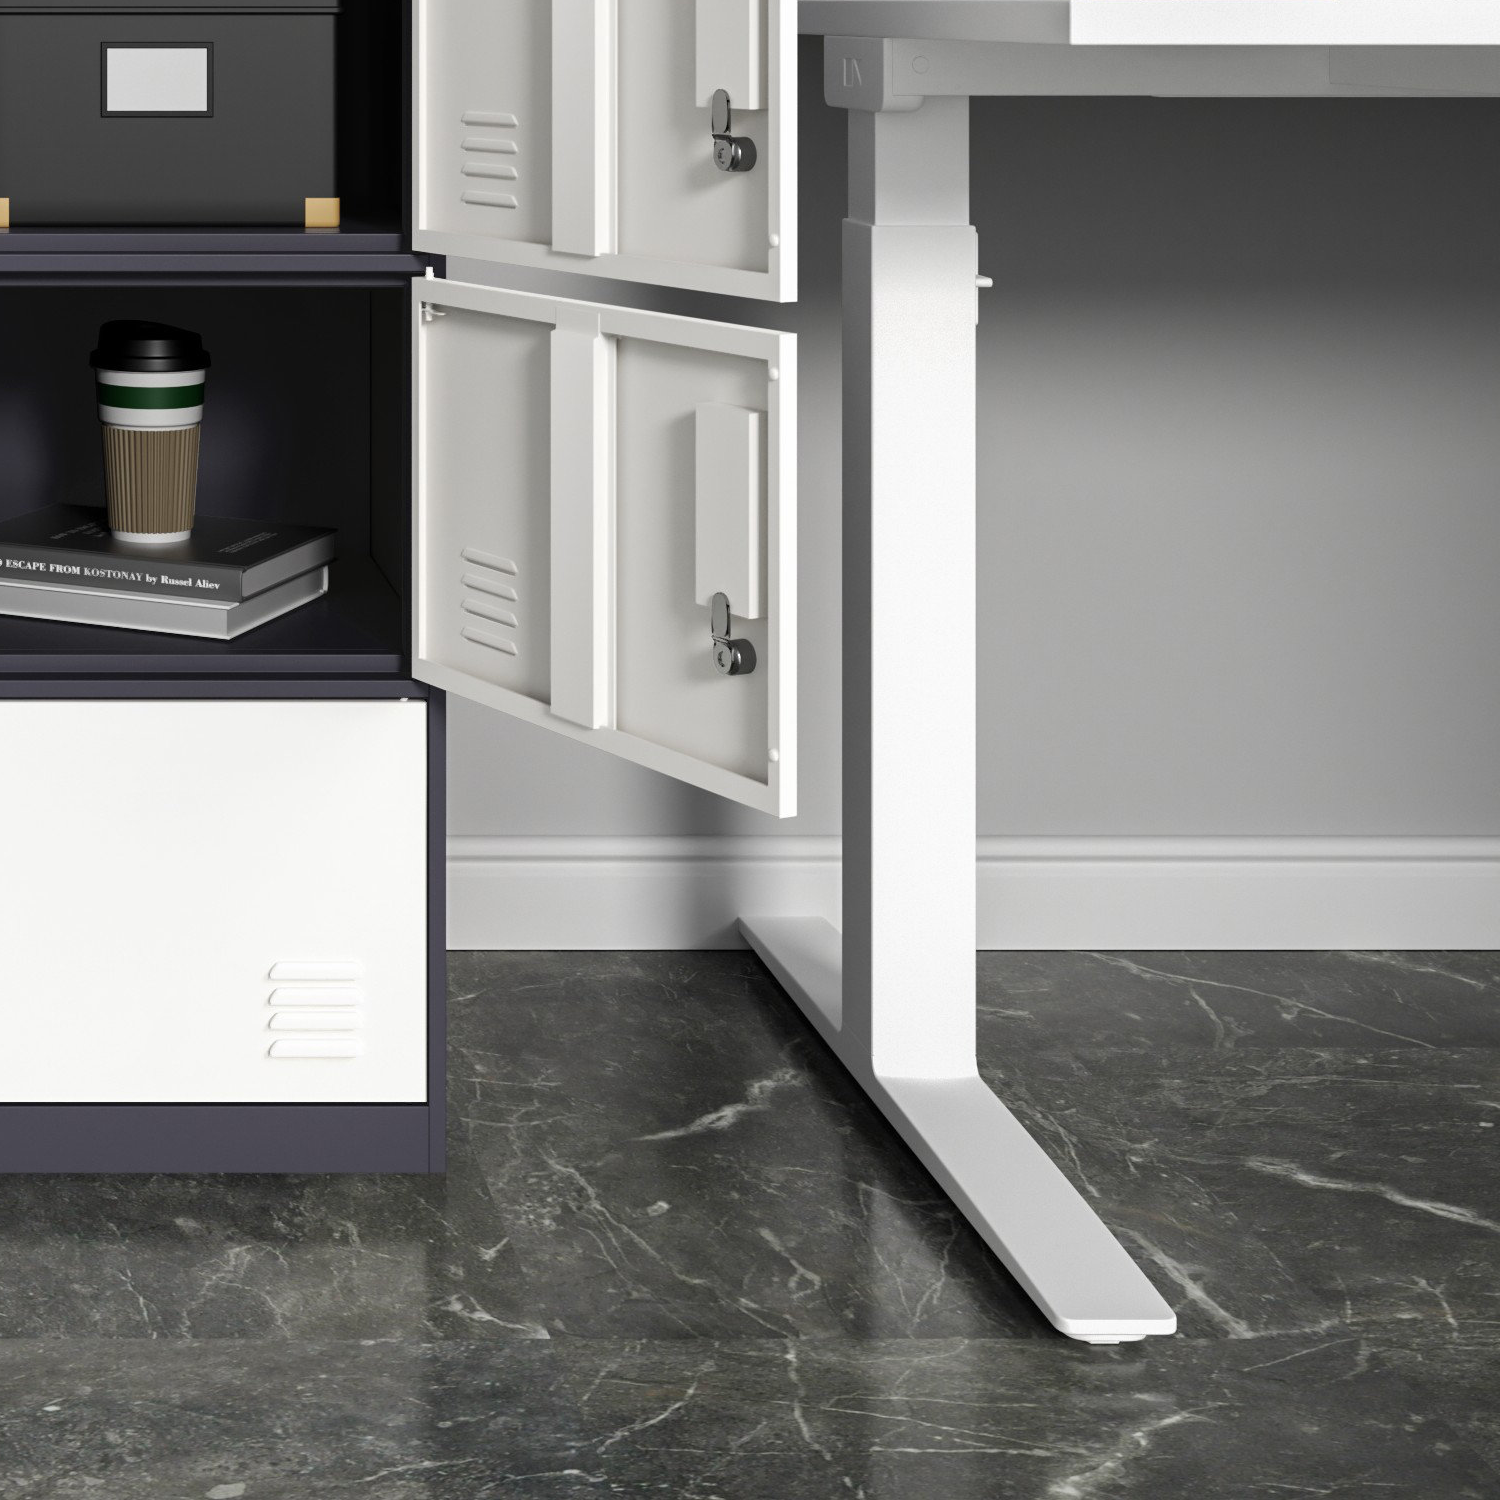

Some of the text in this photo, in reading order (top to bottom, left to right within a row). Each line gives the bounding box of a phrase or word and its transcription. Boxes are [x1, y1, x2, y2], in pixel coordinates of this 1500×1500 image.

[5, 558, 47, 571] ESCAPE
[49, 563, 81, 575] FROM
[83, 567, 143, 581] KOSTONAY
[145, 573, 158, 585] by
[160, 575, 193, 587] Russel
[195, 578, 220, 590] Aliev
